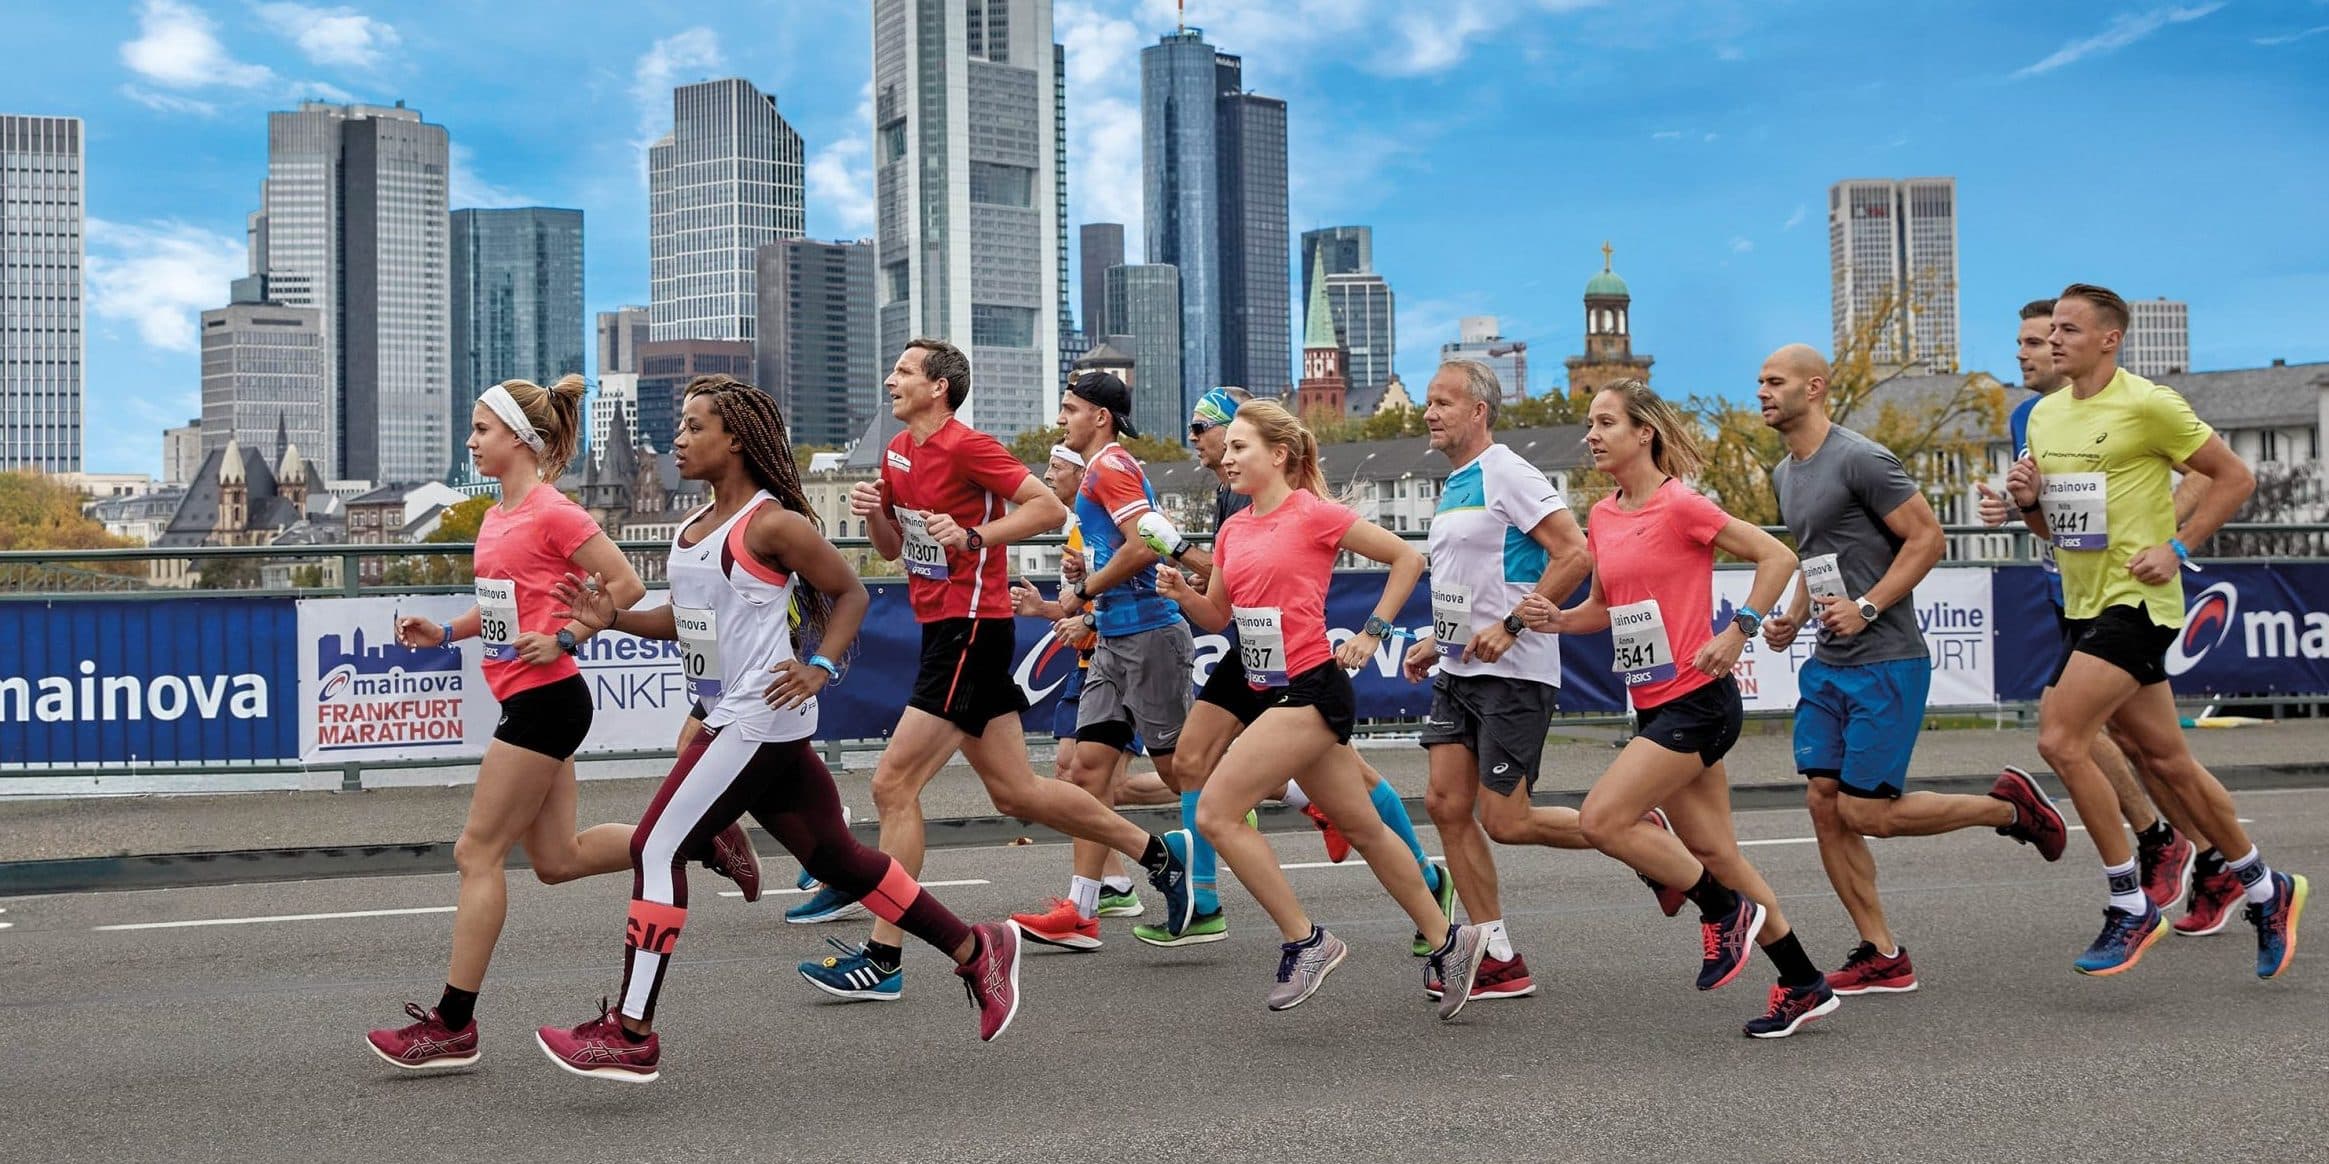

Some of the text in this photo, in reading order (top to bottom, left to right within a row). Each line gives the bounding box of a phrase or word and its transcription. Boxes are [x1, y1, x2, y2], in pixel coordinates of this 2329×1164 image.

[2050, 481, 2097, 493] mainova
[2049, 511, 2089, 532] 3441
[2243, 610, 2329, 658] ma
[684, 652, 705, 676] 10
[353, 673, 463, 695] mainova
[318, 699, 463, 723] FRANKFURT
[318, 720, 463, 745] MARATHON
